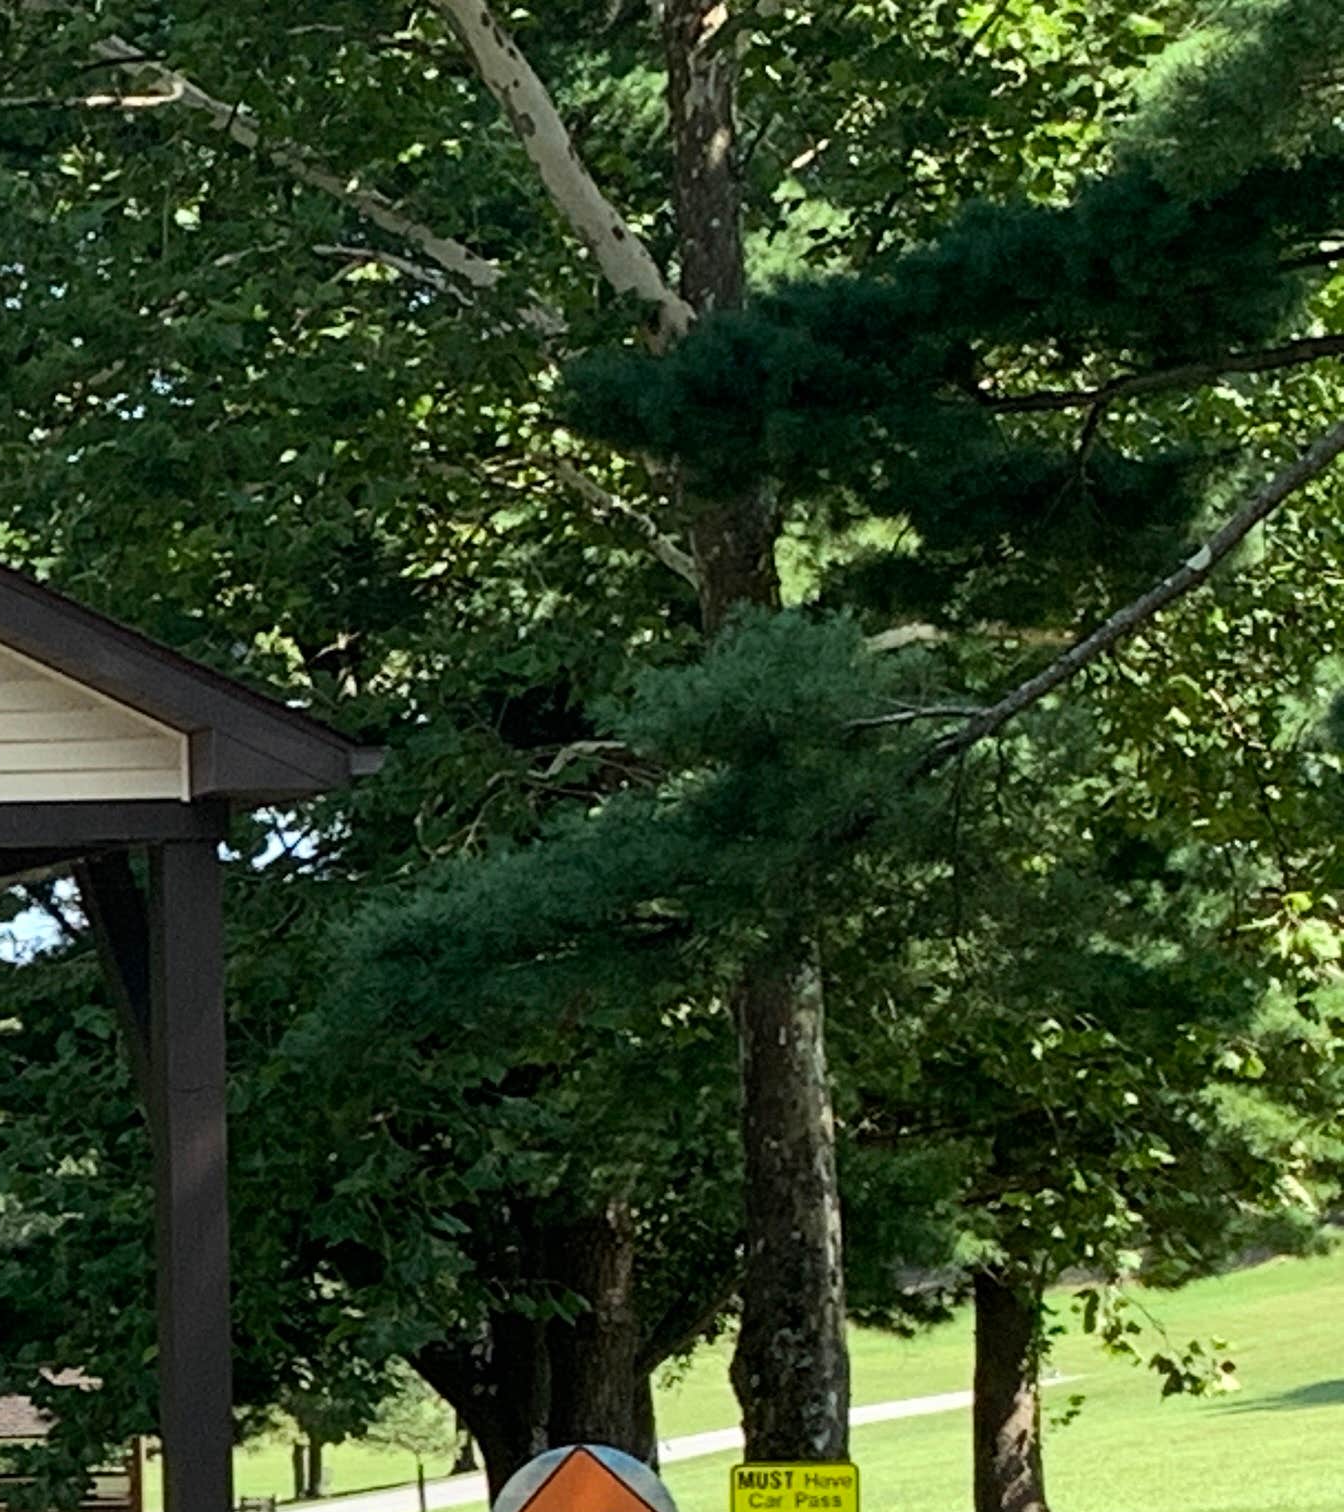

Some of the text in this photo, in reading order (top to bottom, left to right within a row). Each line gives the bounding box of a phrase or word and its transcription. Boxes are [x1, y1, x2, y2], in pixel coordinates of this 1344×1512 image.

[737, 1471, 853, 1490] MUST Have
[748, 1491, 842, 1508] Car Pass
